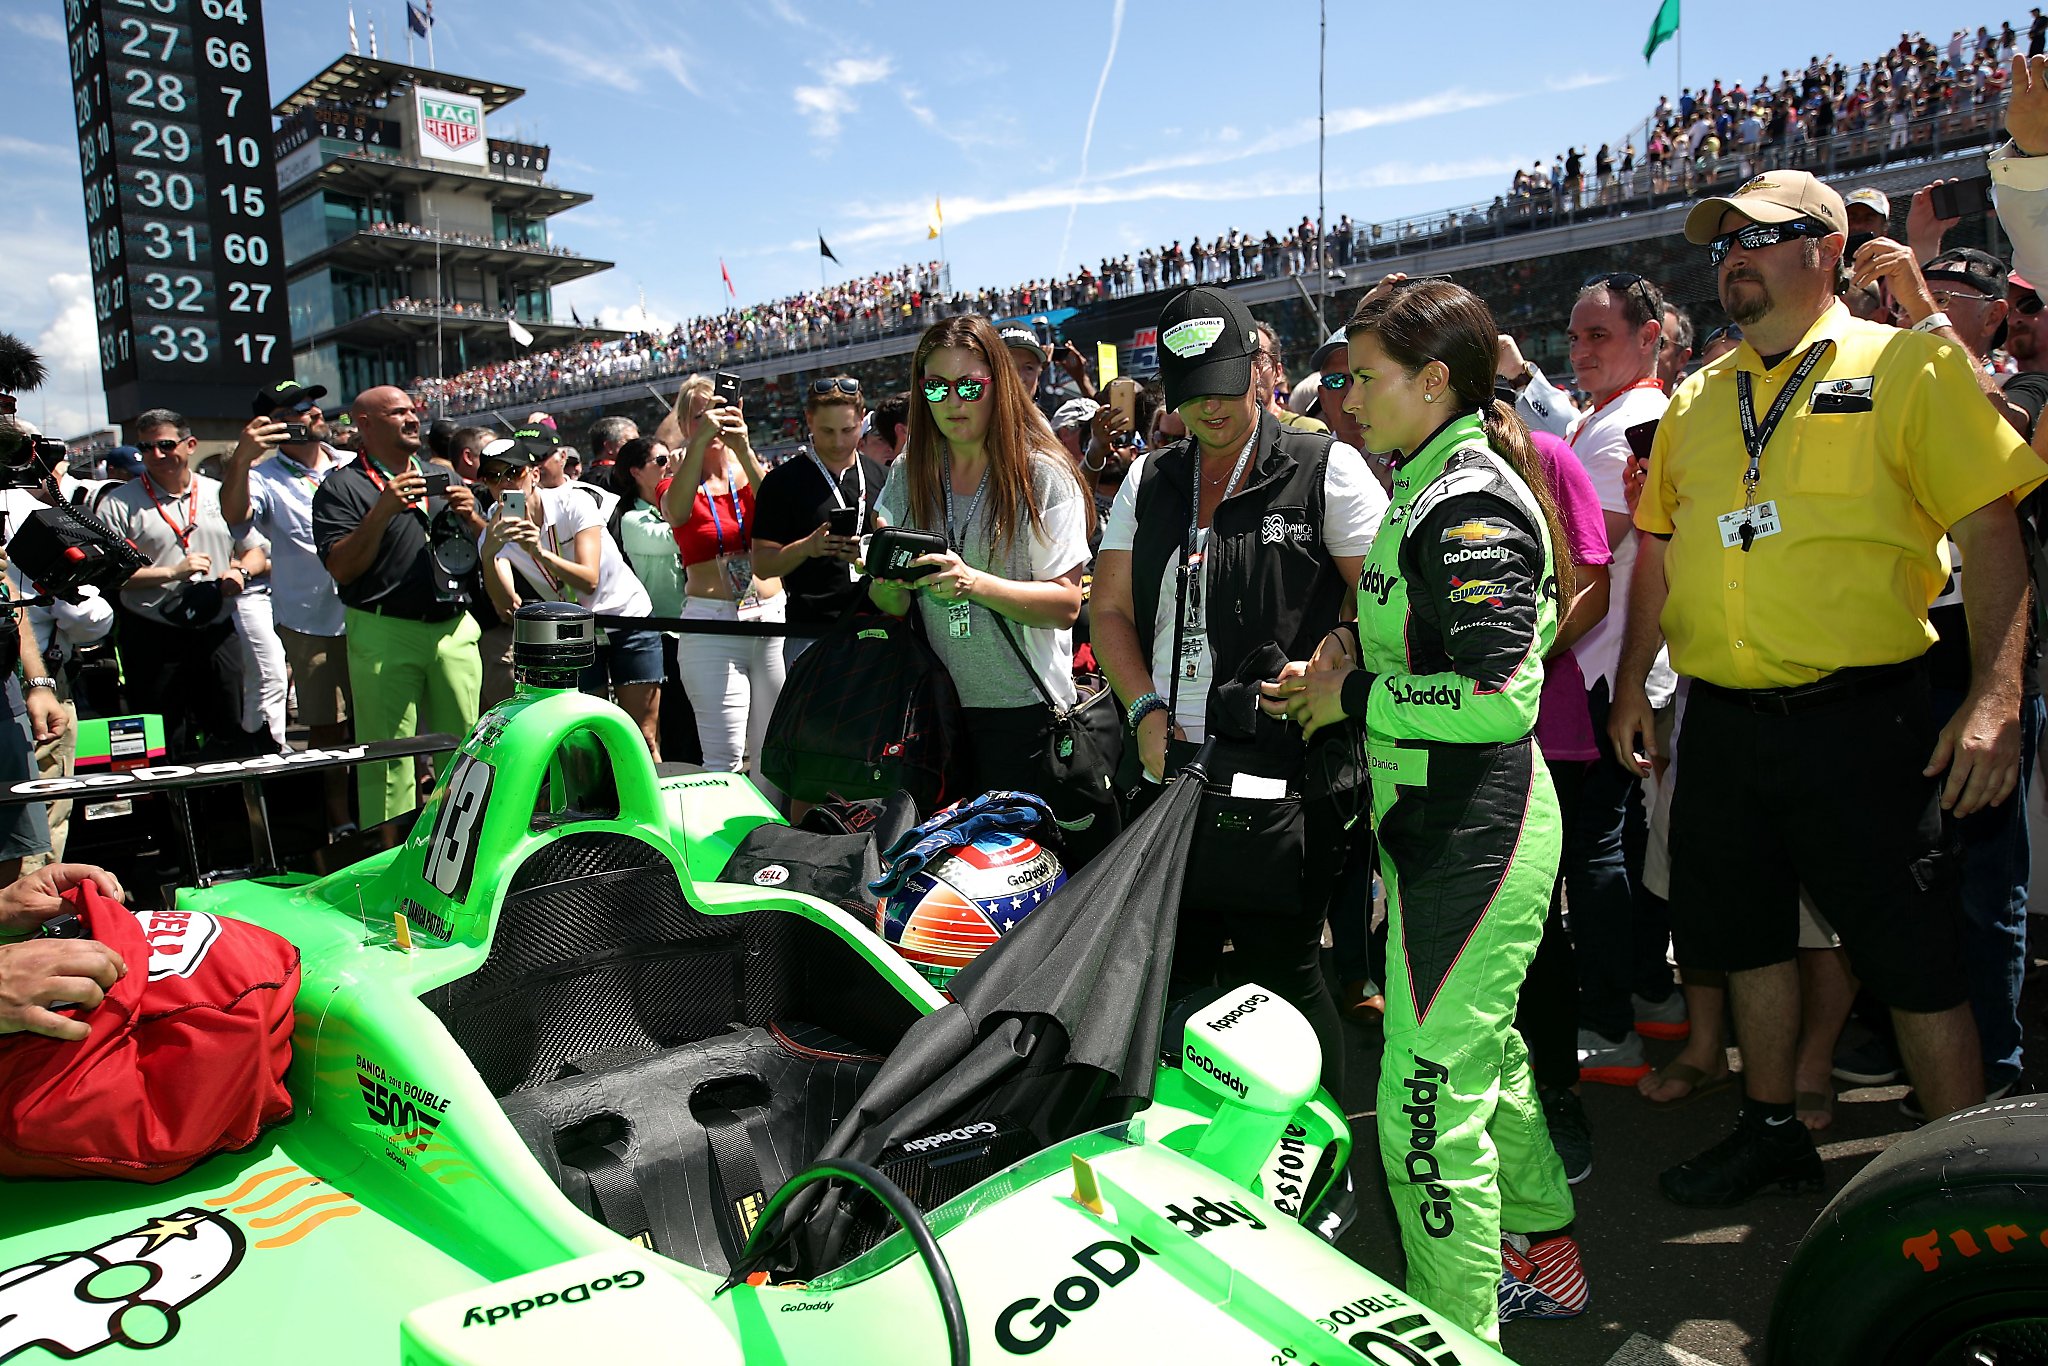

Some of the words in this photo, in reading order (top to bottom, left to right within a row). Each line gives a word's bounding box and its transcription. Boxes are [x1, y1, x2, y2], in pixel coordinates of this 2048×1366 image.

[201, 0, 248, 25] 64
[120, 18, 180, 62] 27
[205, 36, 252, 73] 66
[125, 68, 186, 113] 28
[220, 85, 243, 118] 7
[426, 103, 473, 123] TAG
[130, 120, 191, 163] 29
[216, 133, 260, 168] 10
[320, 123, 328, 136] 1
[337, 125, 346, 139] 2
[355, 128, 363, 141] 3
[371, 131, 380, 145] 4
[425, 120, 476, 146] HEUER
[492, 151, 500, 164] 5
[507, 153, 515, 166] 6
[521, 155, 529, 168] 7
[536, 158, 544, 170] 8
[135, 169, 194, 211] 30
[220, 184, 265, 218] 15
[92, 232, 106, 272] 31
[143, 222, 196, 262] 31
[223, 233, 269, 267] 60
[112, 275, 124, 310] 27
[145, 273, 205, 313] 32
[228, 281, 272, 314] 27
[118, 328, 129, 361] 17
[150, 324, 209, 363] 33
[234, 333, 277, 365] 17
[1164, 327, 1182, 339] DANICA
[1225, 446, 1254, 492] INDYCAR
[966, 483, 985, 521] VERIZON
[1190, 490, 1199, 536] VERIZON
[1285, 523, 1312, 534] DANICA
[1293, 533, 1312, 542] RACING
[1443, 547, 1510, 565] GoDaddy
[1452, 585, 1505, 601] SUNOCO
[10, 746, 367, 794] GoDaddy
[1372, 757, 1398, 771] Danica
[424, 756, 490, 895] 13
[759, 870, 781, 881] BELL
[1007, 862, 1050, 887] GoDaddy
[408, 898, 428, 929] DANICA
[147, 911, 192, 957] BELL
[1206, 993, 1270, 1032] GoDaddy
[356, 1054, 386, 1082] DANICA
[404, 1081, 451, 1114] DOUBLE
[1185, 1045, 1249, 1099] GoDaddy
[376, 1083, 419, 1144] 500
[385, 1147, 407, 1171] GoDaddy
[1402, 1054, 1454, 1239] GoDaddy
[463, 1270, 645, 1328] GoDaddy
[781, 1301, 834, 1312] GoDaddy
